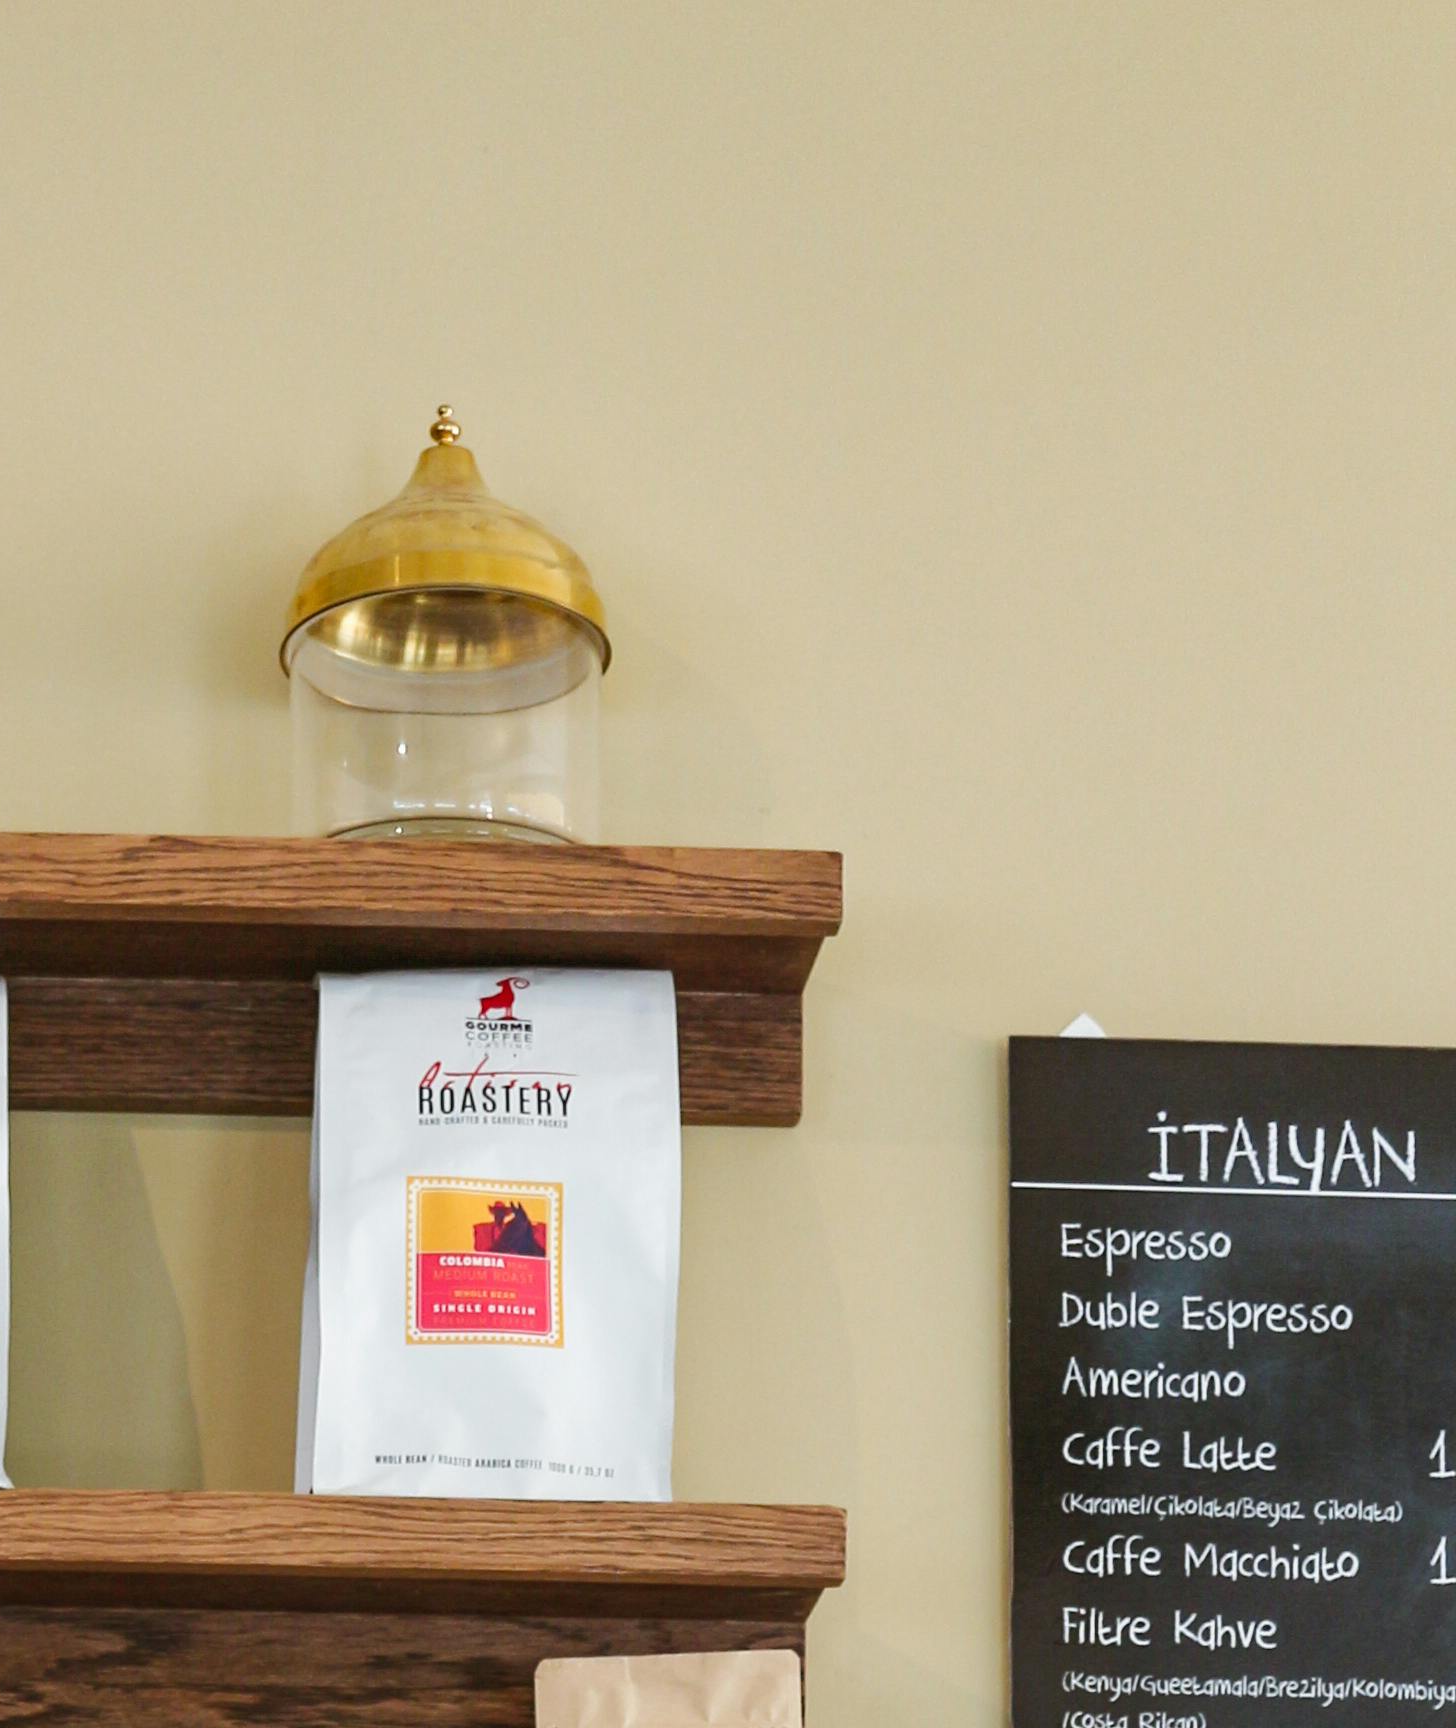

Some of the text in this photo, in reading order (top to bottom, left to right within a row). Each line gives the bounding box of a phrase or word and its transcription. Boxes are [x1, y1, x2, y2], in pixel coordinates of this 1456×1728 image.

[465, 1021, 532, 1032] GOURME
[465, 1031, 532, 1043] COFFEE
[419, 1086, 571, 1117] ROASTERY
[1147, 1110, 1417, 1192] İTALYAN
[439, 1256, 505, 1268] COLOMBIA
[1060, 1223, 1232, 1277] Espresso
[433, 1304, 536, 1315] SINGLE ORIGIN
[1058, 1291, 1353, 1350] Duble Espresso
[1062, 1356, 1246, 1404] Americano
[1062, 1426, 1162, 1471] Caffe
[1183, 1431, 1277, 1473] Latte
[1313, 1499, 1404, 1525] Çikolata)
[1062, 1535, 1162, 1577] Caffe
[1184, 1541, 1359, 1584] Macchiato
[1062, 1607, 1277, 1651] Filtre Kahve
